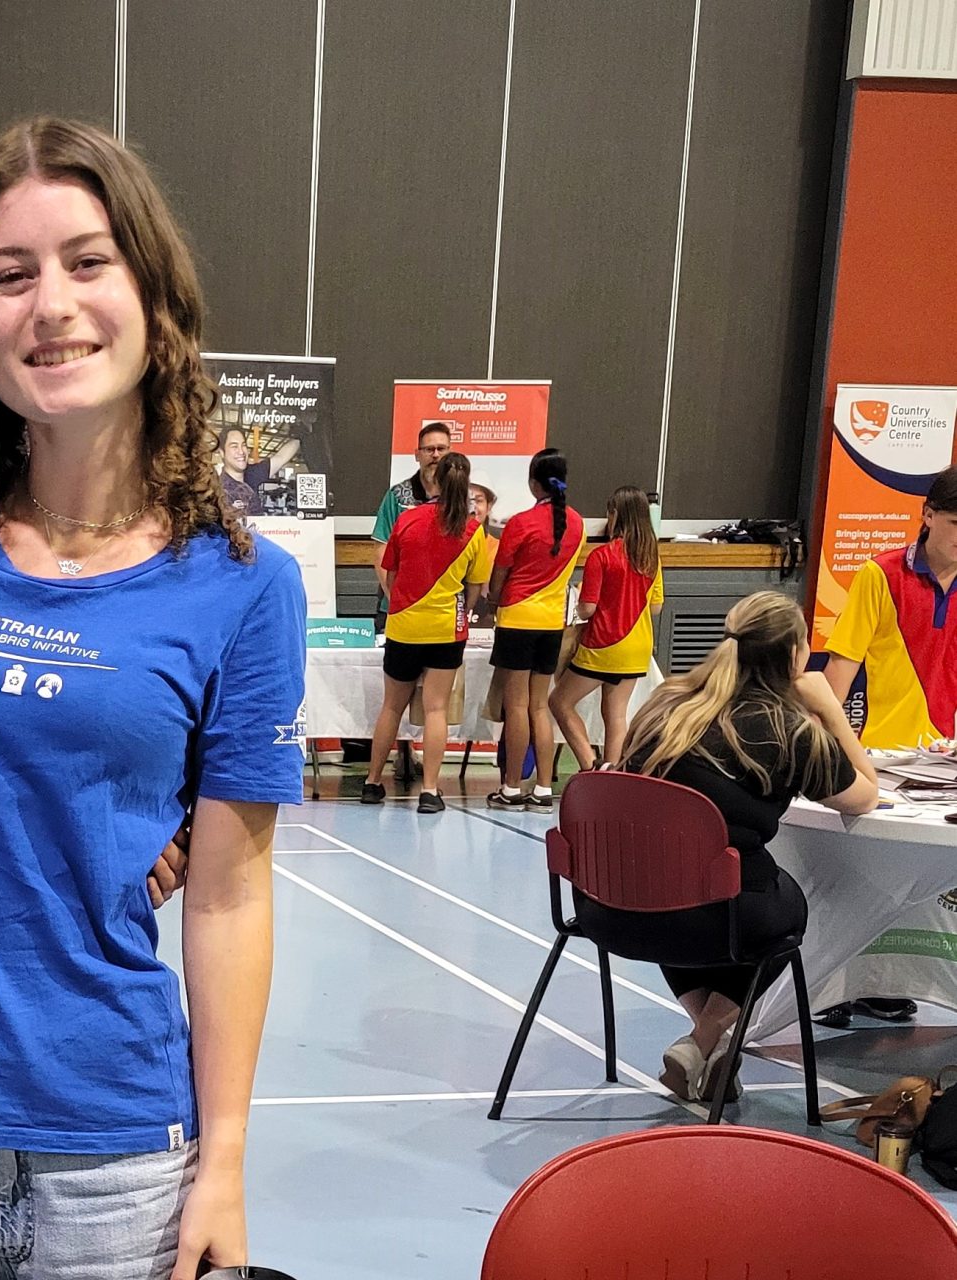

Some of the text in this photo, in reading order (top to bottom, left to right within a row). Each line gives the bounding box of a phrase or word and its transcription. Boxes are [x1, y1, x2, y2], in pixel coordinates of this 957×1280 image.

[218, 372, 319, 394] Assisting Employers
[222, 391, 318, 410] to Build a Stronger
[439, 402, 506, 413] Apprenticeships
[891, 405, 931, 418] Country
[244, 408, 296, 427] Workforce
[890, 417, 947, 429] Universities
[888, 429, 921, 440] Centre
[835, 530, 906, 541] Bringing degrees
[834, 541, 906, 551] closer to regional
[833, 552, 853, 560] rural
[854, 552, 871, 560] and
[349, 627, 360, 635] are
[32, 640, 100, 660] INITIATIVE
